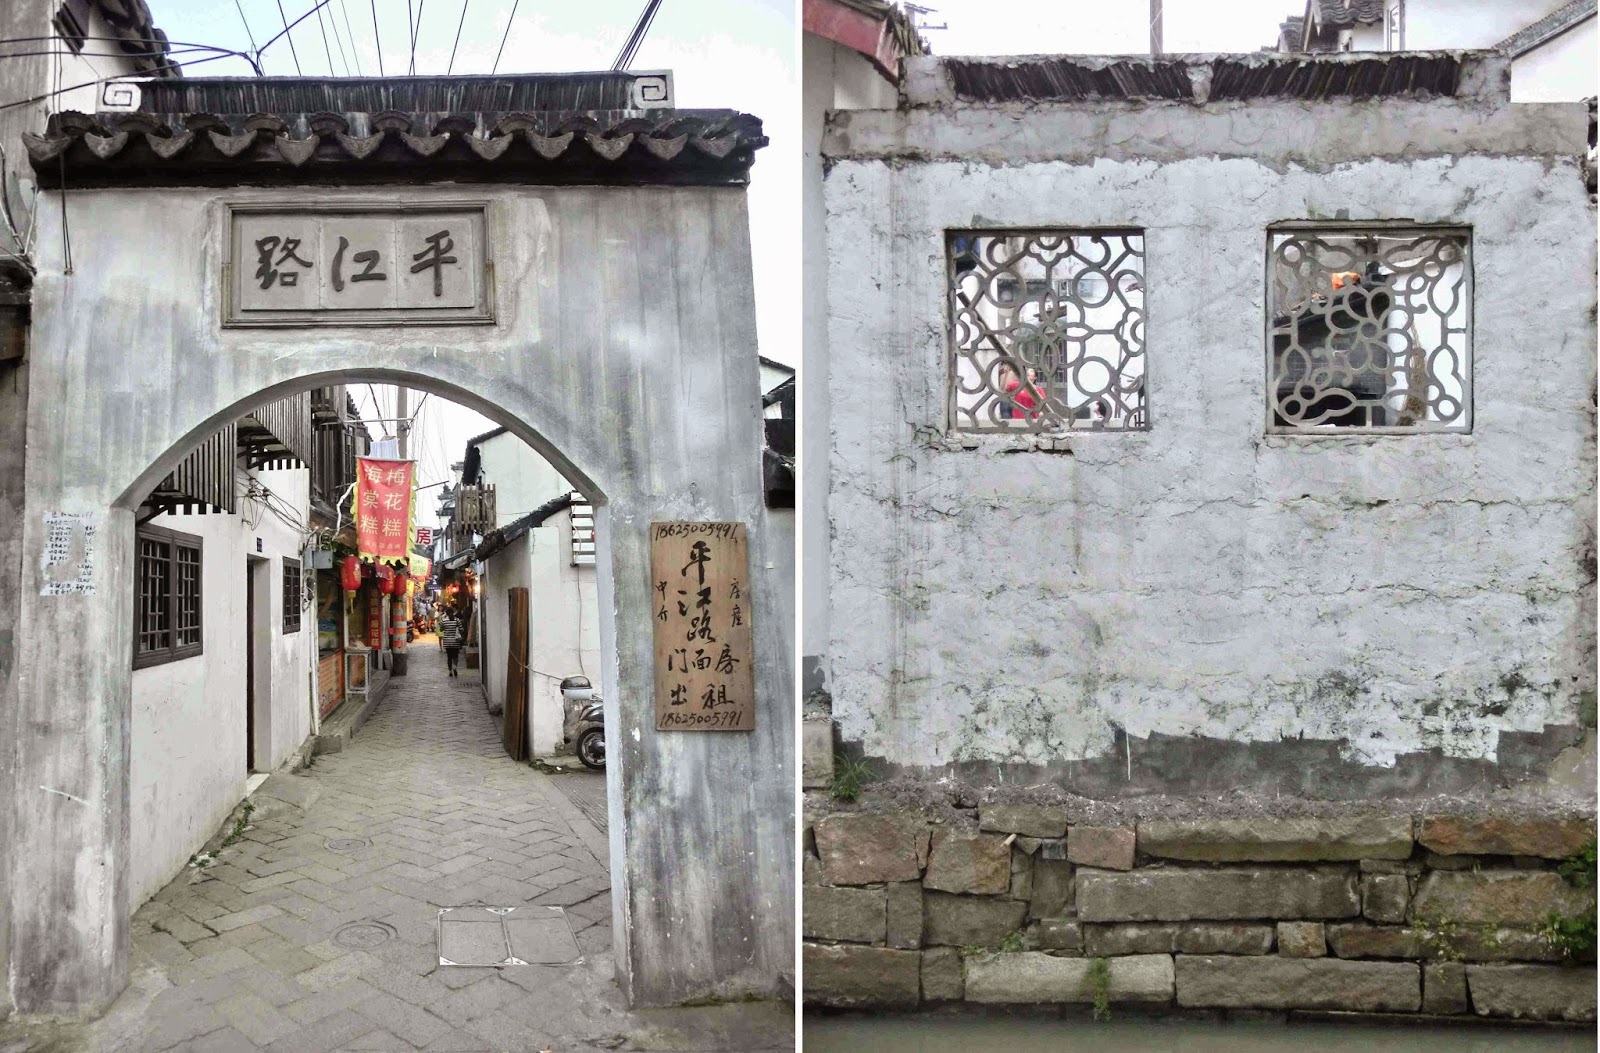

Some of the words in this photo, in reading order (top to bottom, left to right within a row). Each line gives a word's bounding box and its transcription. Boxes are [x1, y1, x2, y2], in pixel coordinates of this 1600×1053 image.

[360, 465, 383, 535] 海棠糕
[382, 468, 406, 537] 梅花糕
[416, 528, 431, 545] 房
[655, 523, 738, 544] 18625005991
[655, 581, 668, 622] 中介
[677, 540, 717, 644] 平江路
[668, 643, 740, 675] 门面房
[670, 683, 735, 709] 出租
[660, 710, 742, 727] 18625005991
